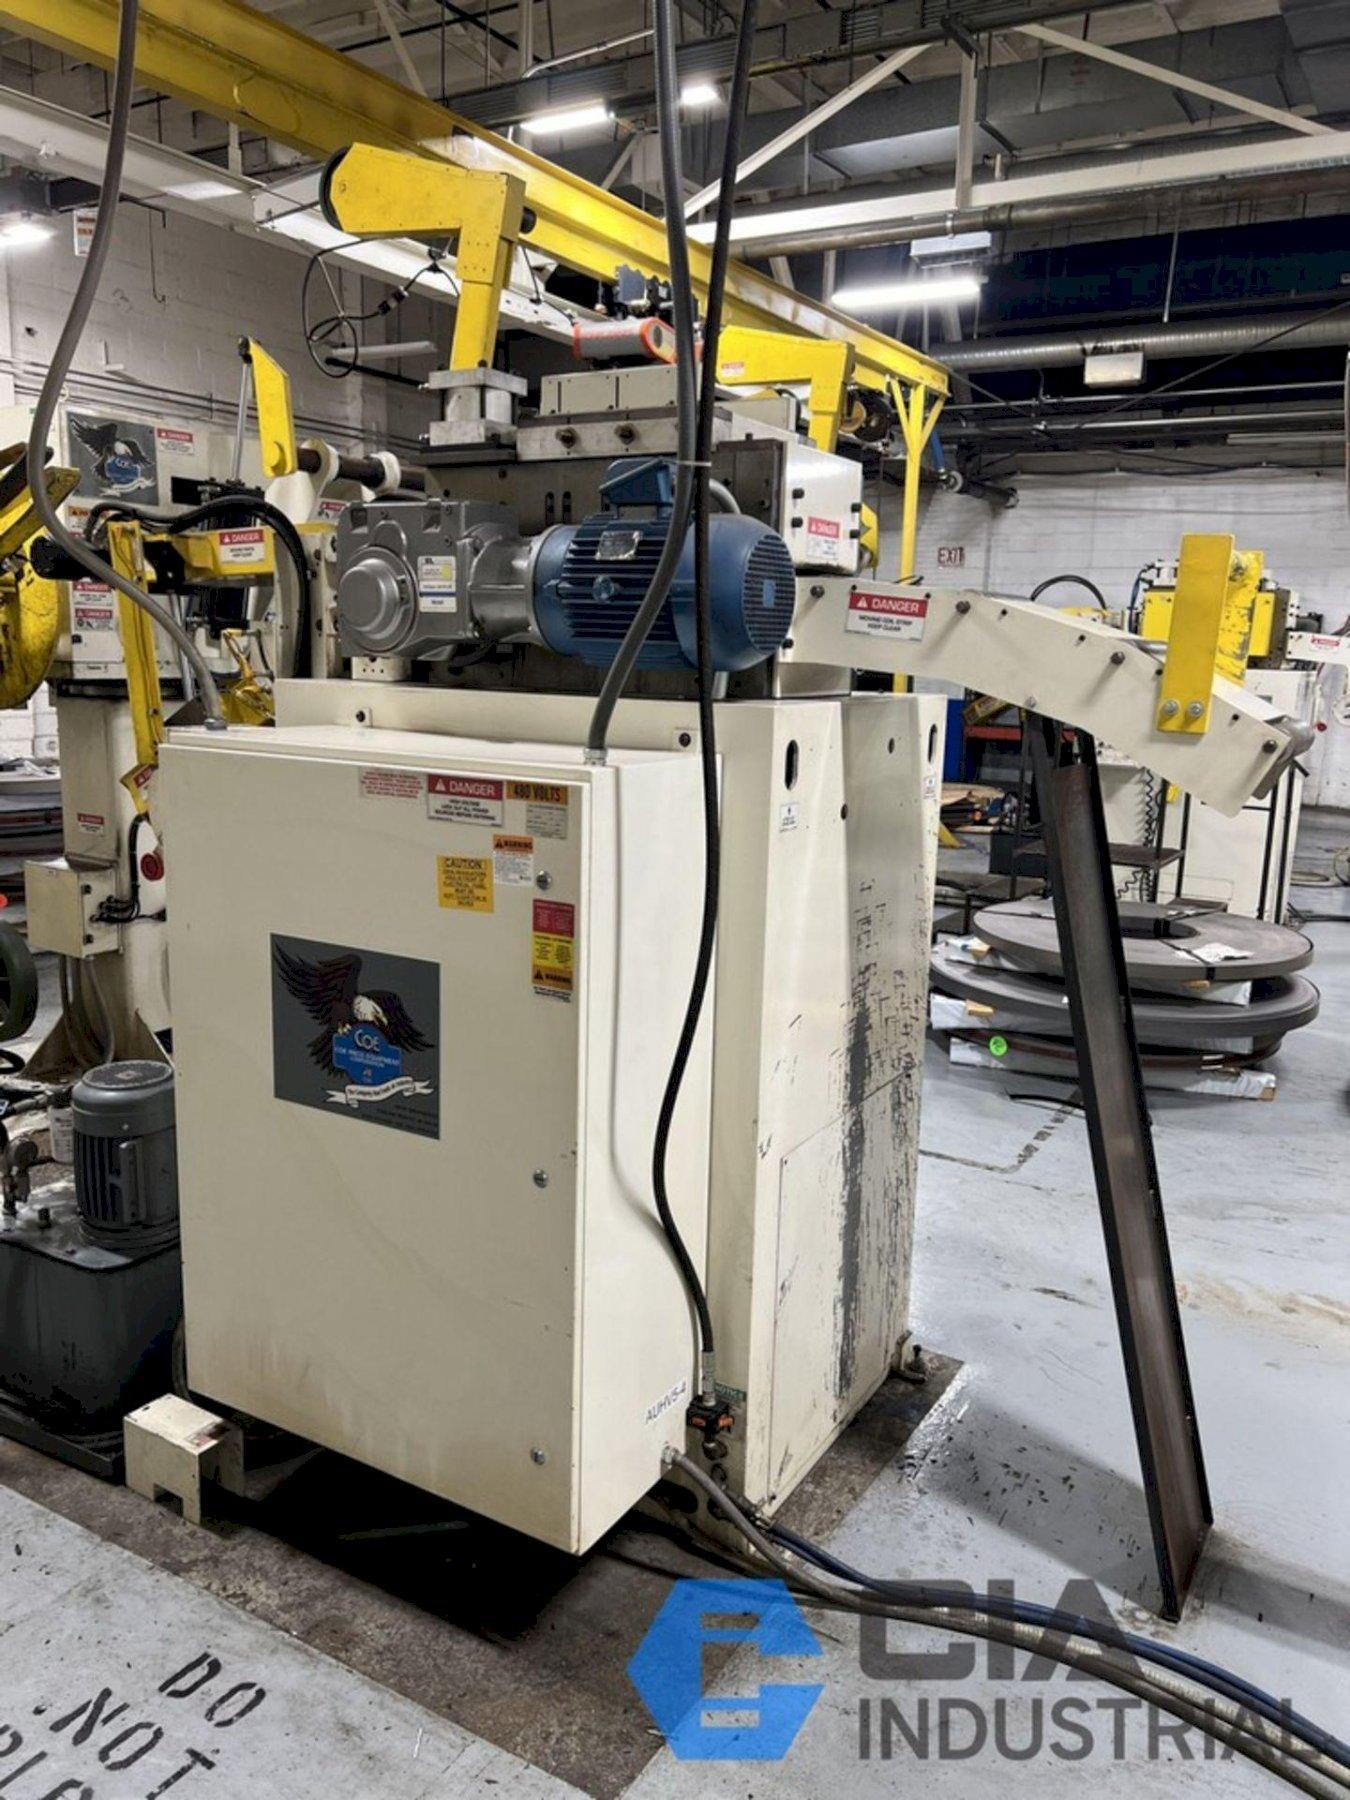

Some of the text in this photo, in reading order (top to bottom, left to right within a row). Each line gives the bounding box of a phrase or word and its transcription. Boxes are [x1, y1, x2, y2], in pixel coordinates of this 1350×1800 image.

[231, 533, 260, 543] DANGER
[938, 547, 965, 566] EXIT
[872, 598, 919, 613] DANGER
[449, 780, 495, 796] DANGER
[535, 785, 561, 801] VOLTS
[445, 857, 482, 870] CAUTION
[158, 1651, 267, 1728] DO
[49, 1686, 217, 1800] NOT
